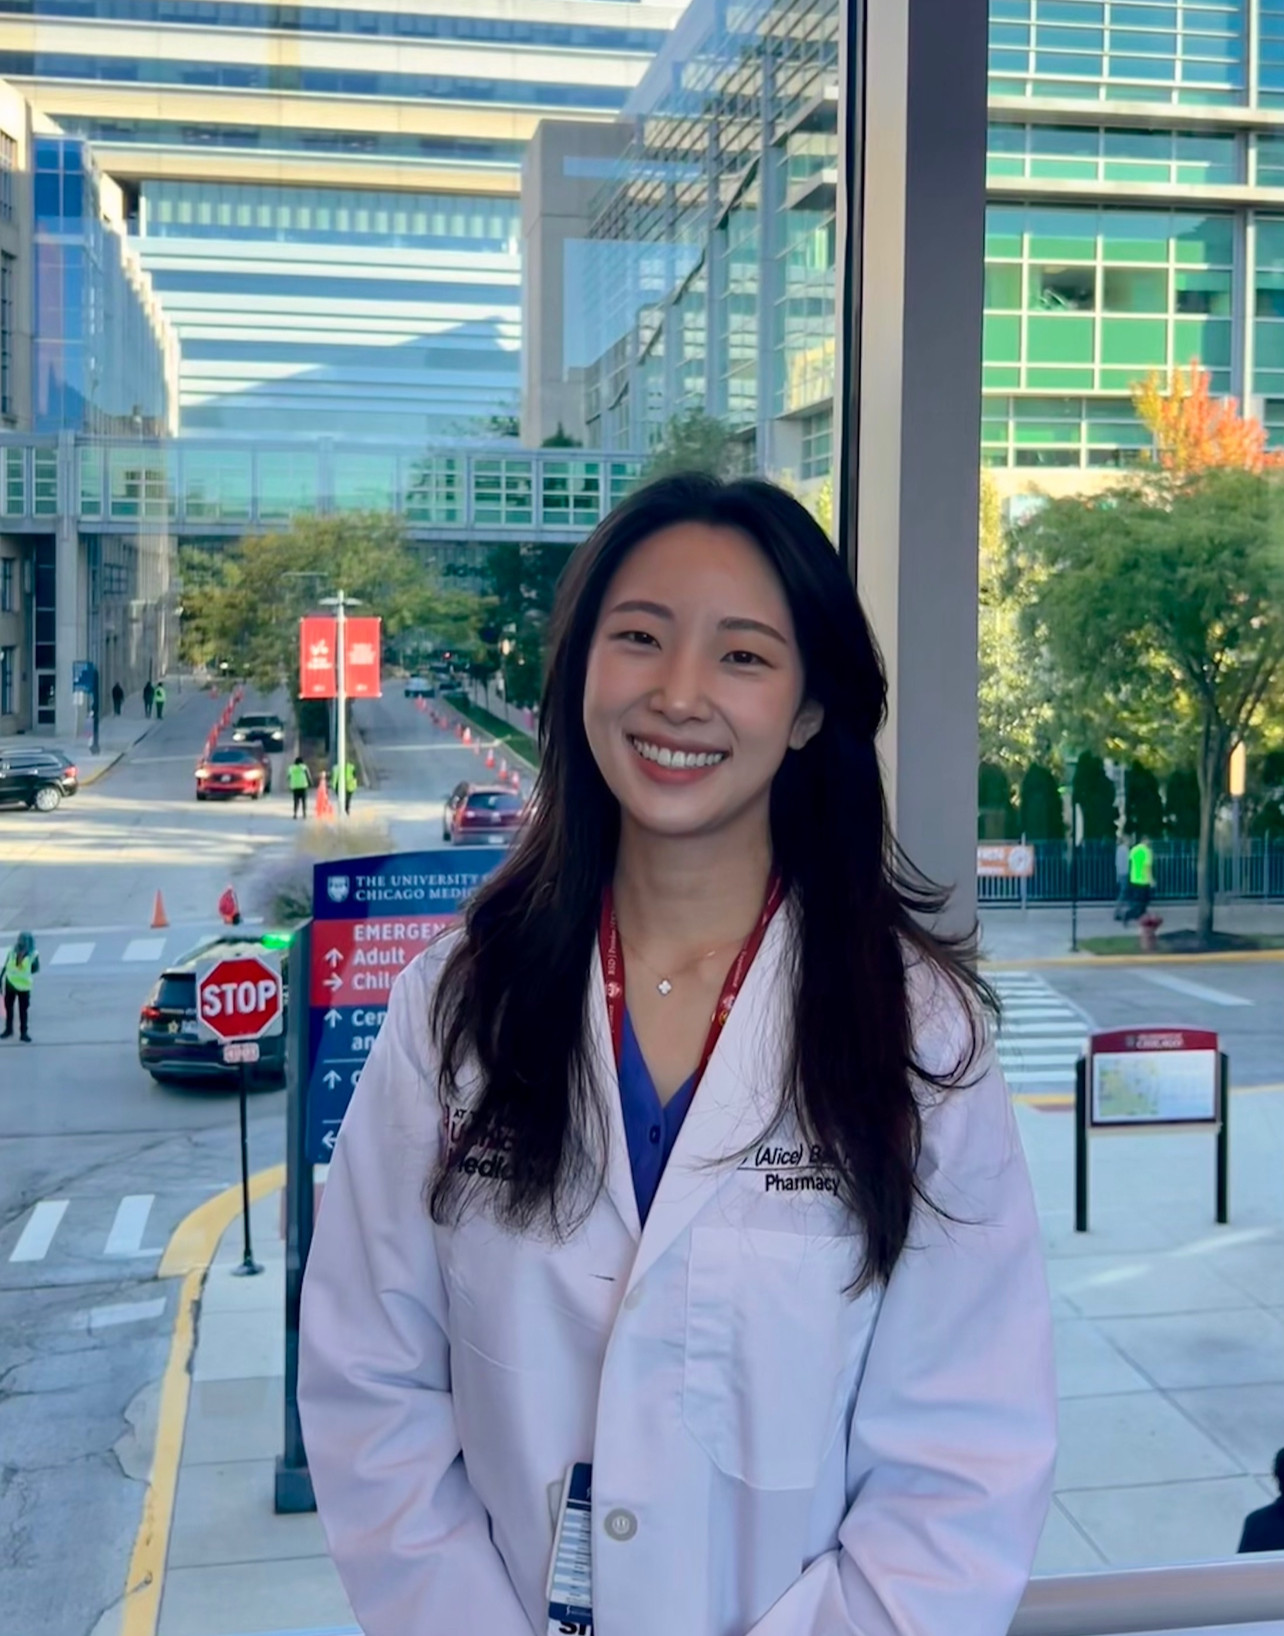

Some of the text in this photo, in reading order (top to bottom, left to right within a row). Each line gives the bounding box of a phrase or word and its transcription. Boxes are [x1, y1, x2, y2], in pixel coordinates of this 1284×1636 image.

[355, 874, 386, 887] THE
[391, 873, 479, 887] UNIVERSITY
[355, 887, 477, 901] CHICAGO MEDIC
[354, 922, 446, 941] EMERGEN
[353, 947, 405, 965] Adult
[352, 971, 396, 990] Chil
[202, 979, 277, 1017] STOP
[351, 1009, 387, 1027] Cen
[351, 1035, 375, 1051] an
[755, 1143, 803, 1167] (Alice)
[765, 1174, 840, 1197] Pharmacy
